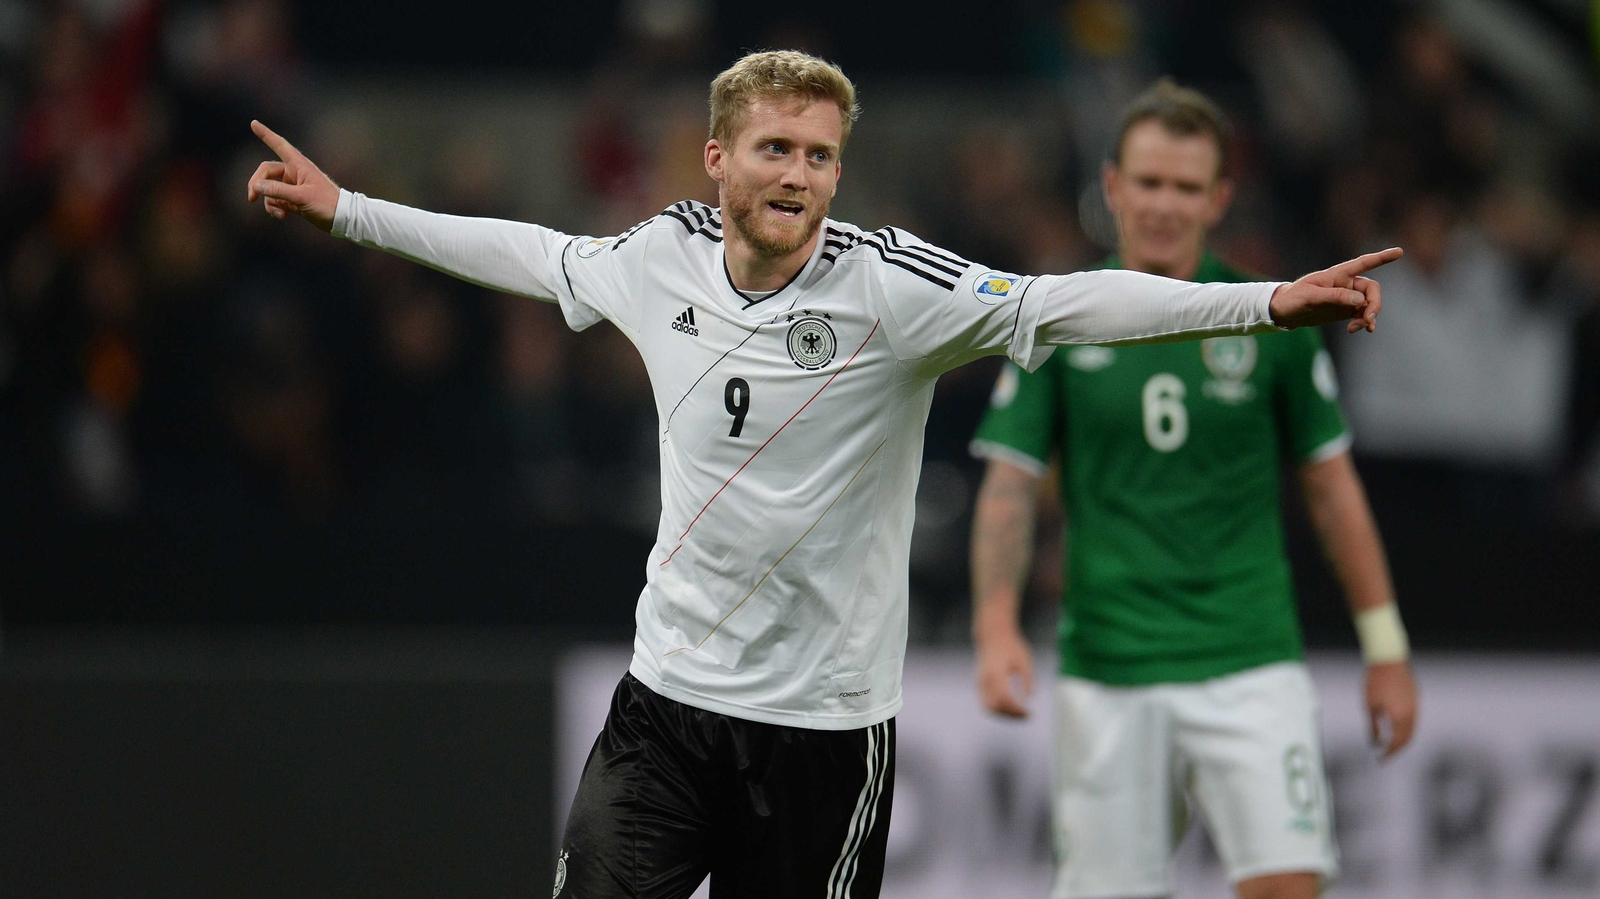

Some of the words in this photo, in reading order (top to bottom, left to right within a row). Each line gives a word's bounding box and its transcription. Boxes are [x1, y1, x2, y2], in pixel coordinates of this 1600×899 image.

[671, 321, 699, 337] adidas
[796, 323, 825, 335] DEUTSCHER
[724, 377, 750, 438] 9
[1142, 373, 1189, 453] 6
